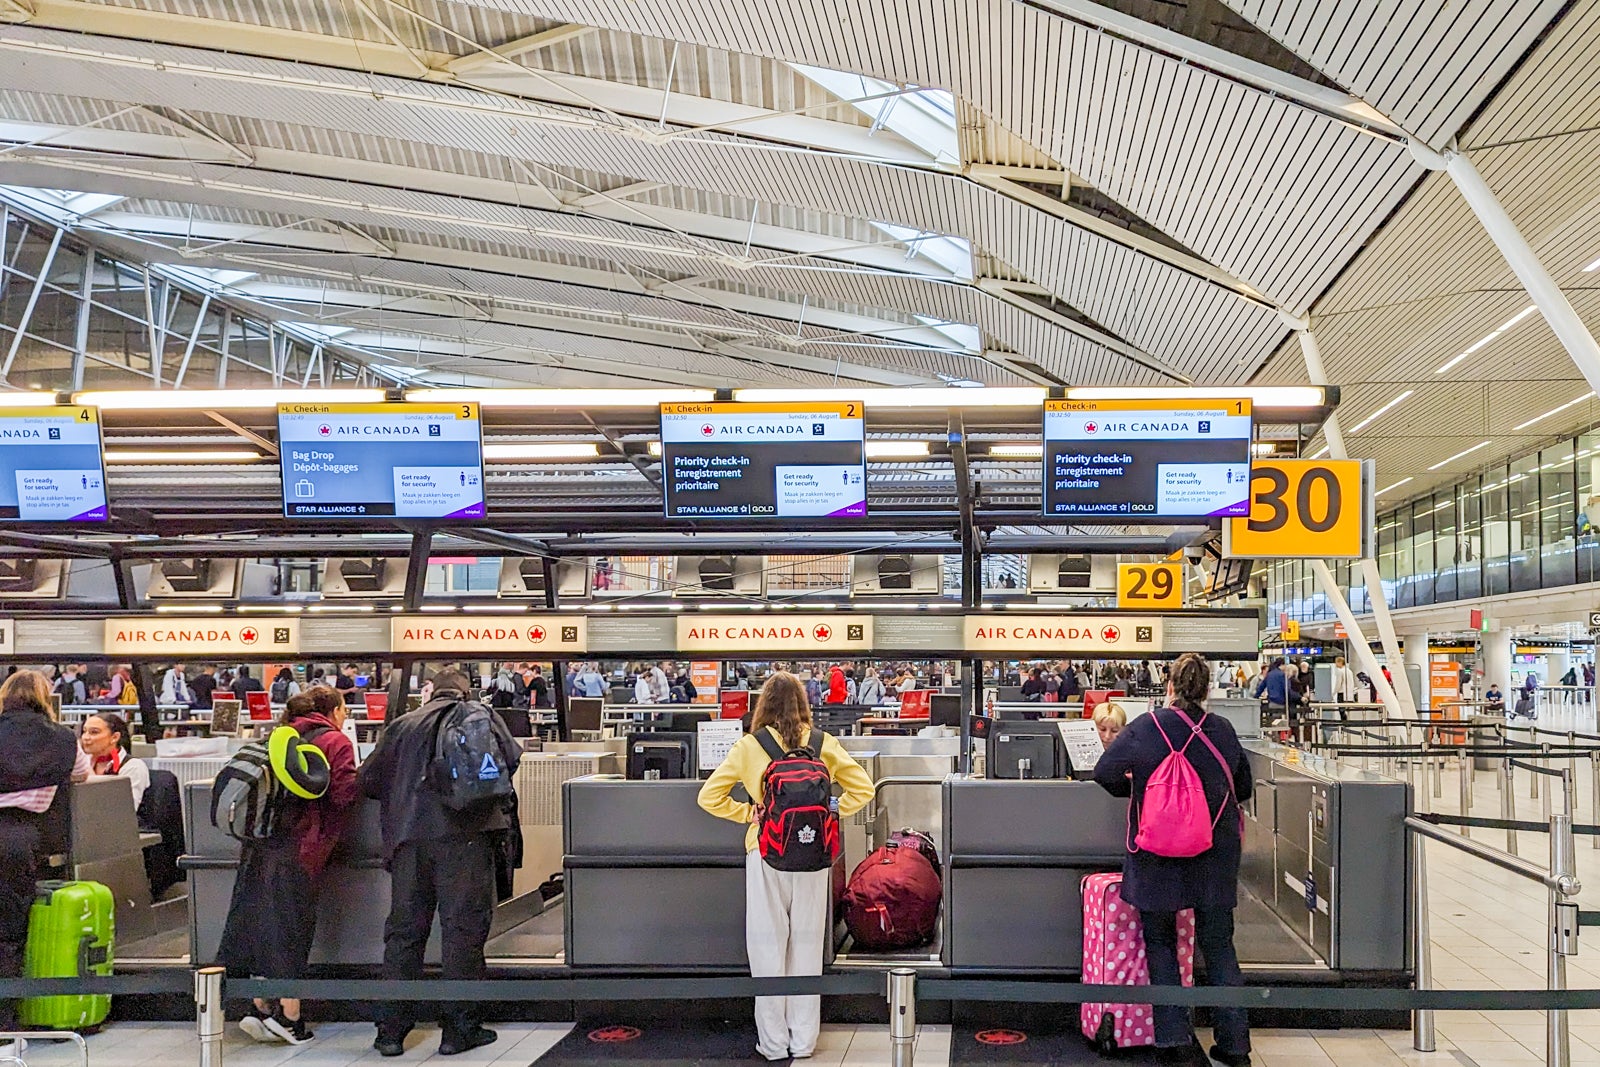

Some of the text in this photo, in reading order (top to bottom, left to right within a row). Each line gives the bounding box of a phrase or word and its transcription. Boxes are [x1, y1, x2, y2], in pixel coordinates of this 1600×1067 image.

[462, 405, 470, 418] 3
[846, 404, 855, 416] 2
[1235, 401, 1242, 414] 1
[81, 409, 90, 421] 4
[338, 426, 420, 434] AIR CANADA
[720, 425, 804, 434] AIR CANADA
[1103, 423, 1189, 432] AIR CANADA
[292, 451, 334, 462] Bag Drop
[674, 456, 750, 467] Priority check-in
[1055, 454, 1132, 465] Priority check-in
[293, 463, 359, 474] Dépôt-bagages
[1055, 467, 1123, 477] Enregistrement
[675, 469, 742, 480] Enregistrement
[675, 481, 719, 492] prioritaire
[1055, 479, 1099, 490] prioritaire
[1248, 466, 1342, 532] 30
[1126, 567, 1173, 600] 29
[115, 630, 231, 642] AIR CANADA
[403, 628, 519, 640] AIR CANADA
[688, 627, 805, 639] AIR CANADA
[975, 627, 1093, 639] AIR CANADA
